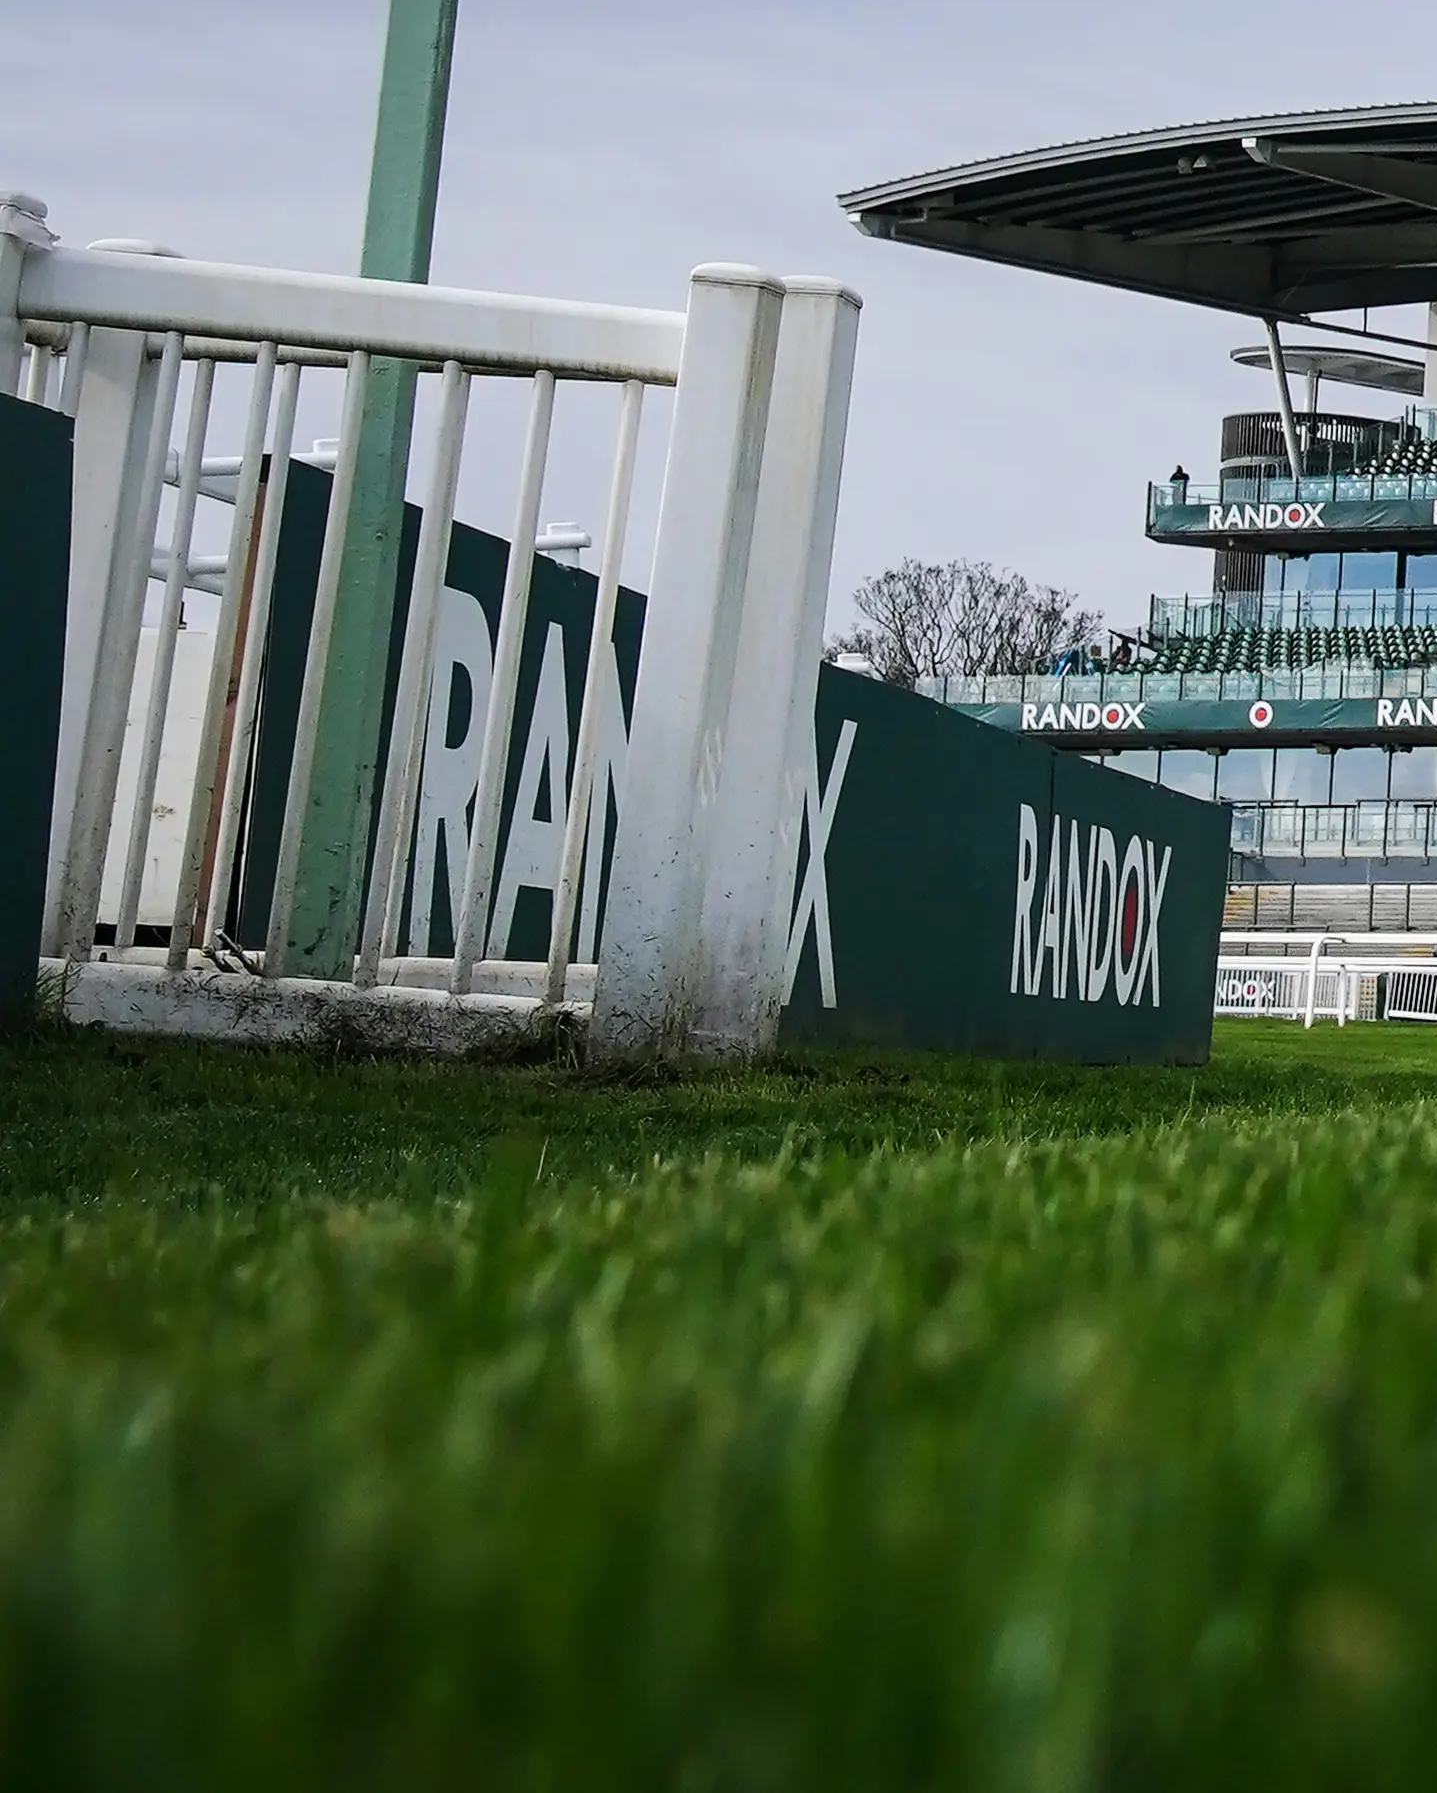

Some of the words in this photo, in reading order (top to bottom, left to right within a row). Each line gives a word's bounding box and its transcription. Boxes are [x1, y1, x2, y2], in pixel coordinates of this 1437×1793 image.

[1208, 502, 1326, 530] RANDOX
[1021, 701, 1146, 730] RANDOX
[1010, 803, 1172, 1007] RANDOX
[1218, 979, 1275, 1001] NDOX
